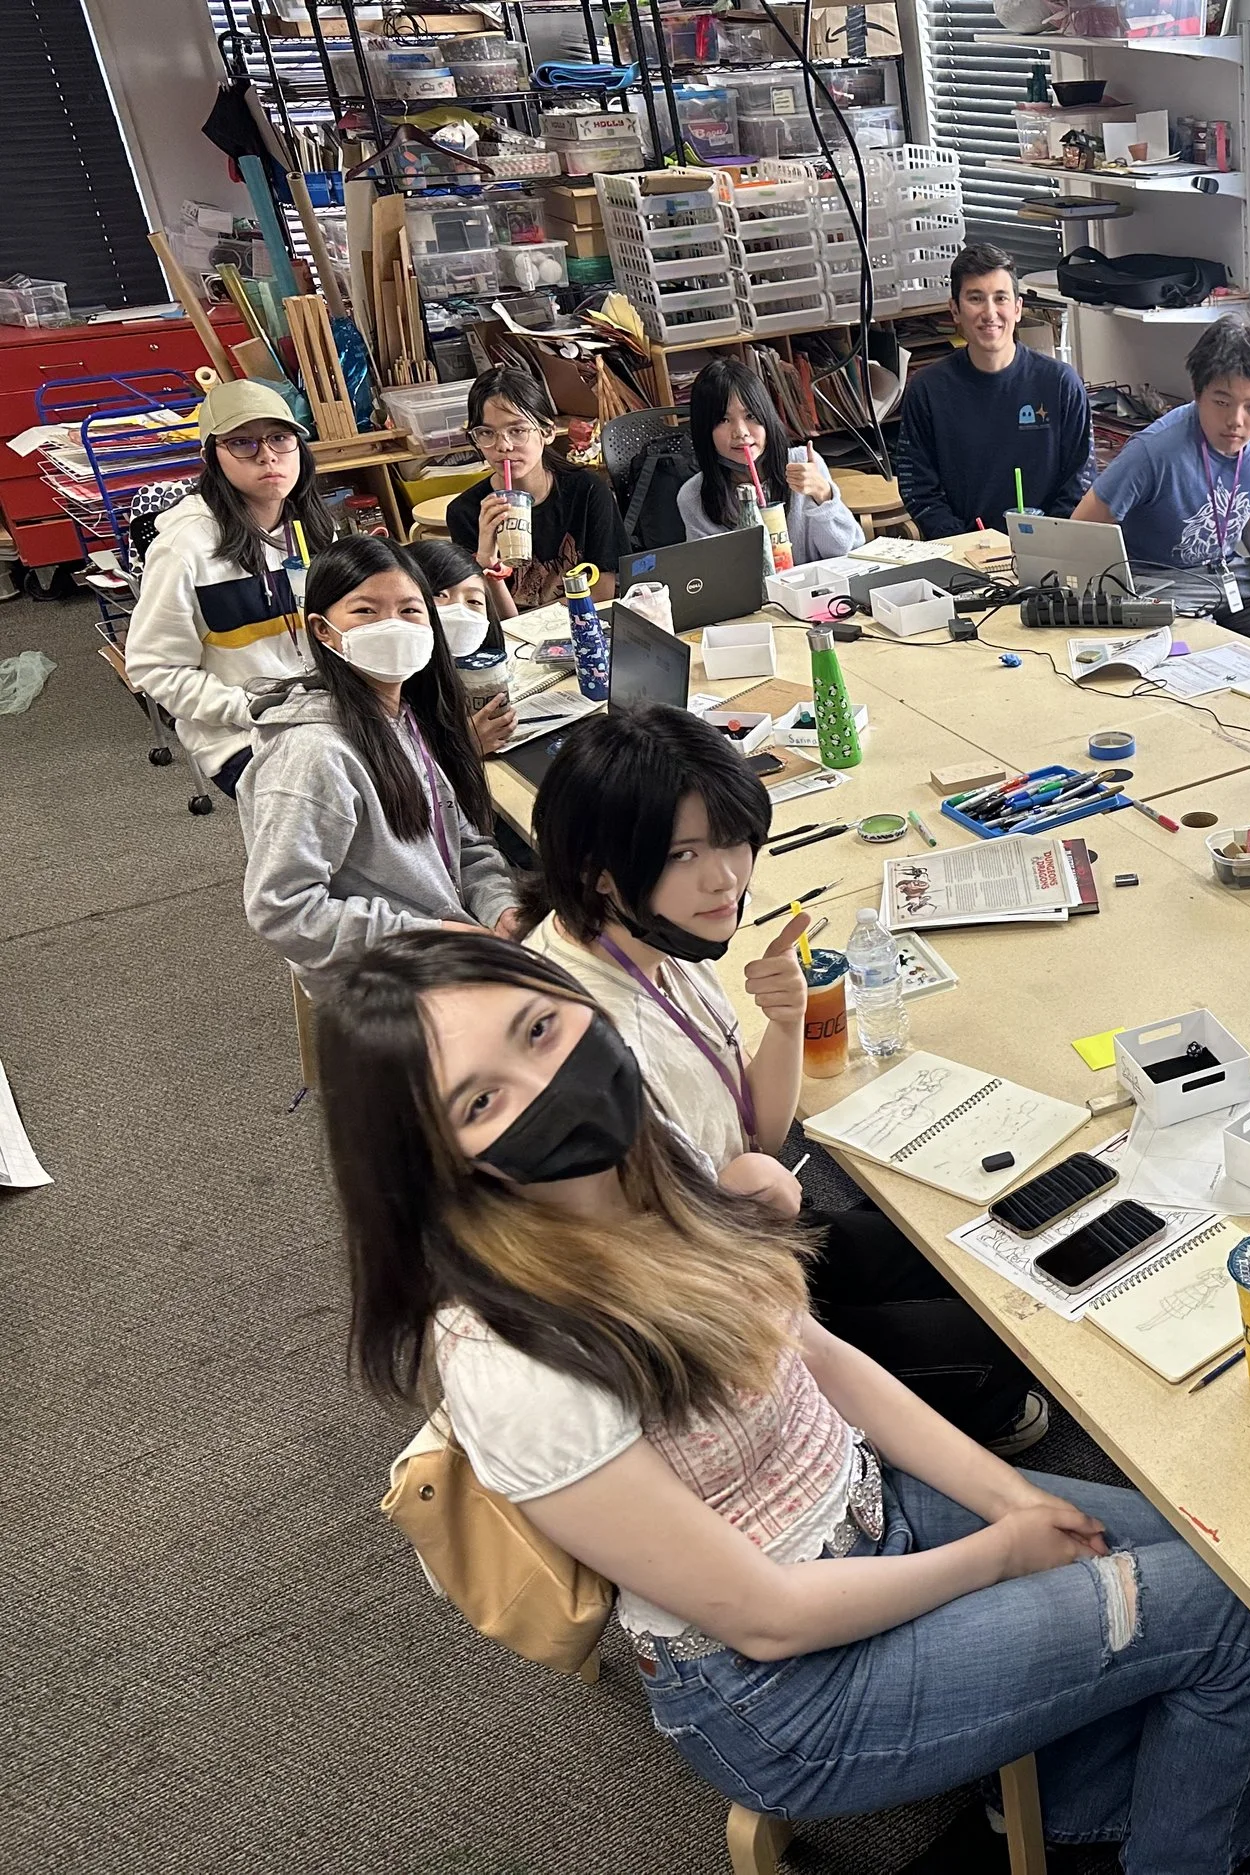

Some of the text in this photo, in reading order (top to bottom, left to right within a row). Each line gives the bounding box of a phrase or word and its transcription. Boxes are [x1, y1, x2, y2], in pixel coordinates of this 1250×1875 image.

[593, 119, 625, 129] HOLLY
[1036, 861, 1050, 890] DRAGONS
[1043, 850, 1058, 886] DUNGEONS
